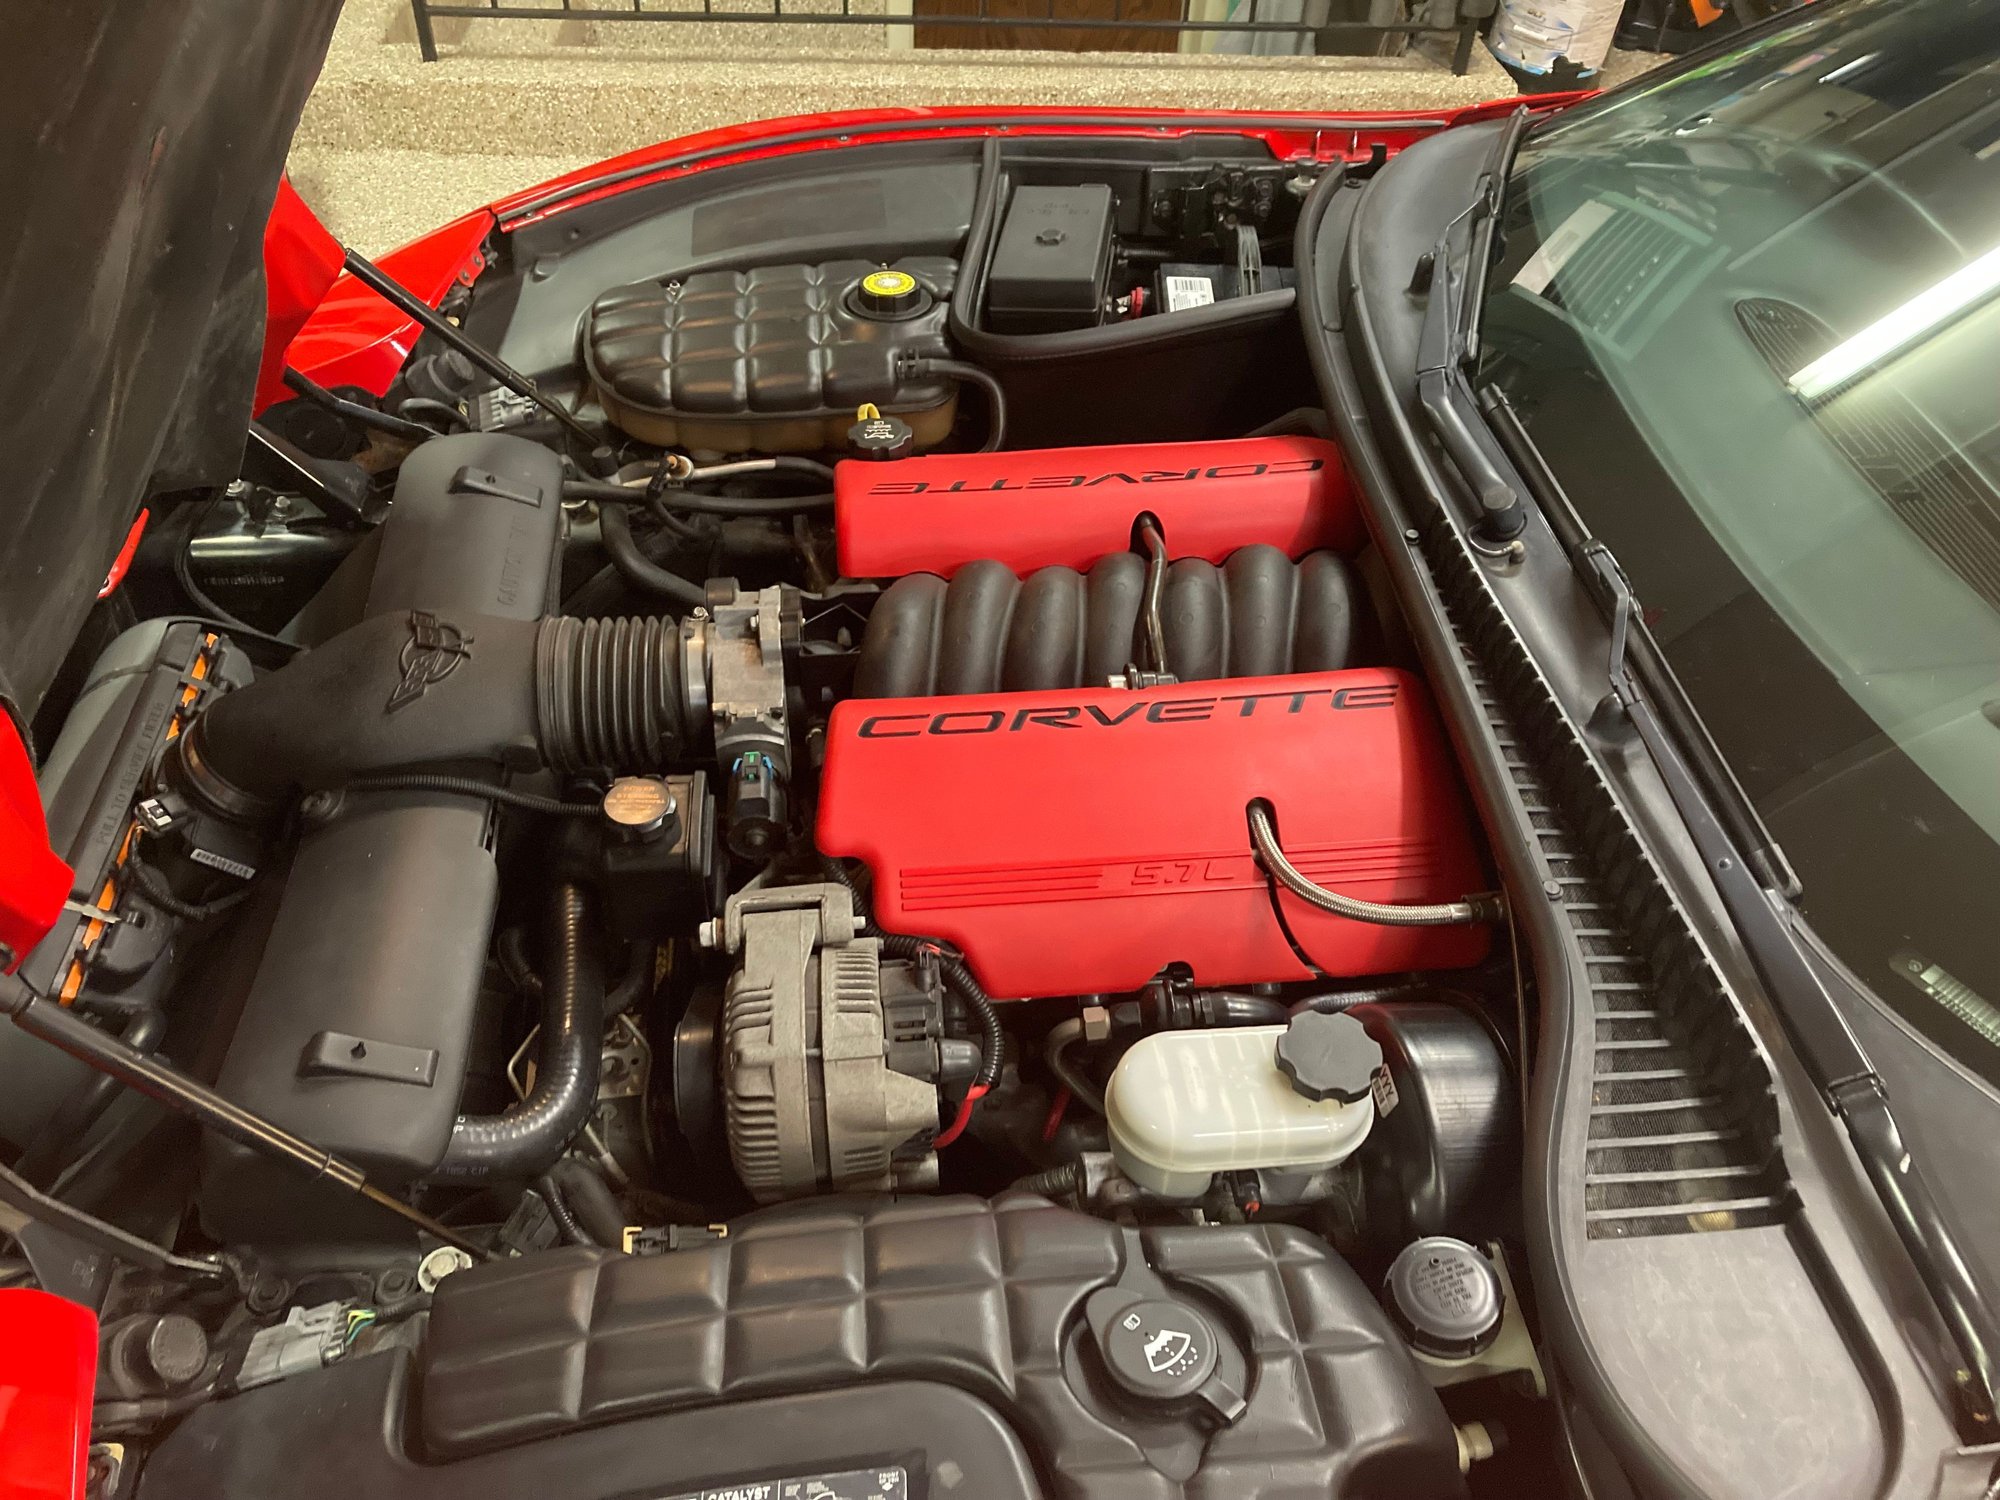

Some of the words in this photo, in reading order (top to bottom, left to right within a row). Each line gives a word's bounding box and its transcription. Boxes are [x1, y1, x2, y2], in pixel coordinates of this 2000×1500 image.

[868, 459, 1324, 495] CORVETTE
[858, 684, 1399, 738] CORVETTE
[1131, 861, 1235, 886] 5.7L
[708, 1485, 771, 1500] CATALYST
